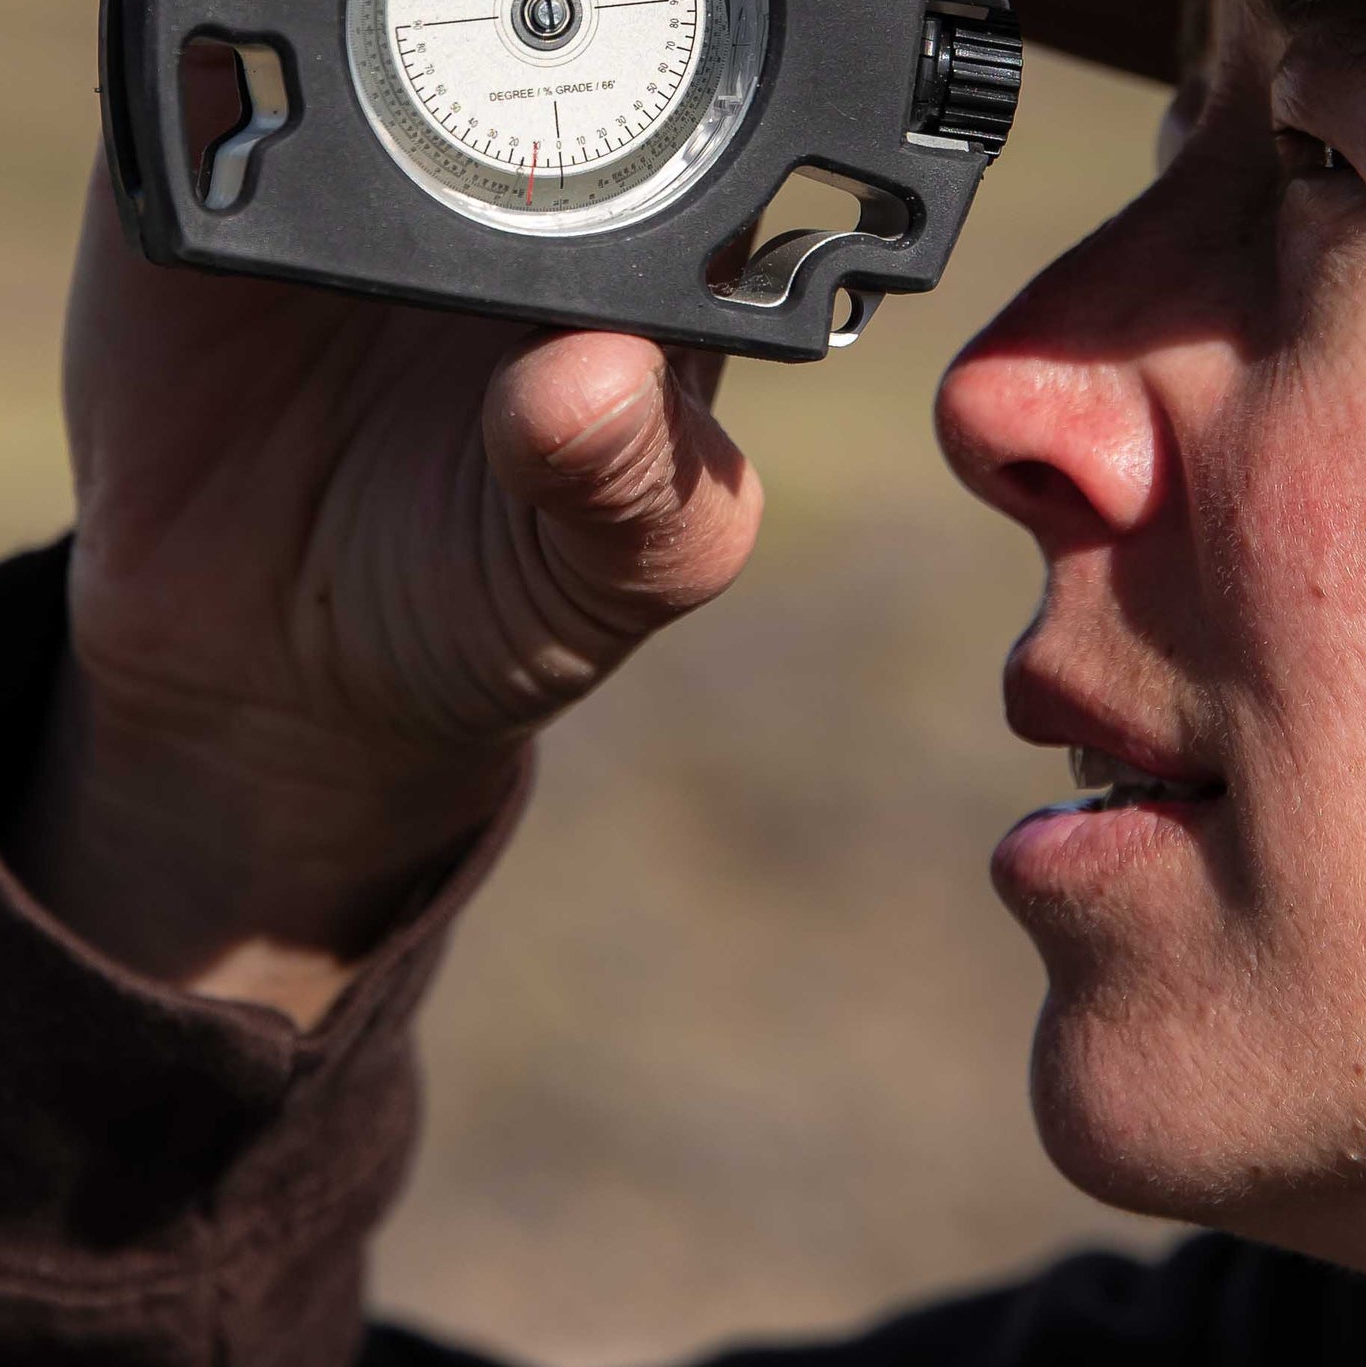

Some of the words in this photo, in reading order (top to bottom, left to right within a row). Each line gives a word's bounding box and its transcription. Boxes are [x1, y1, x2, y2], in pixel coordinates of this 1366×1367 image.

[669, 18, 679, 29] 80
[416, 42, 427, 54] 80
[665, 40, 676, 51] 70
[424, 63, 435, 75] 70
[657, 62, 669, 74] 60
[489, 88, 534, 102] DEGREE
[543, 87, 553, 96] %
[555, 82, 593, 95] GRADE
[646, 82, 658, 94] 50
[633, 100, 644, 111] 40
[467, 117, 479, 129] 40
[615, 116, 627, 127] 30
[487, 128, 498, 139] 30
[596, 127, 608, 139] 20
[508, 136, 520, 147] 20
[556, 140, 562, 150] 0
[576, 135, 586, 145] 10
